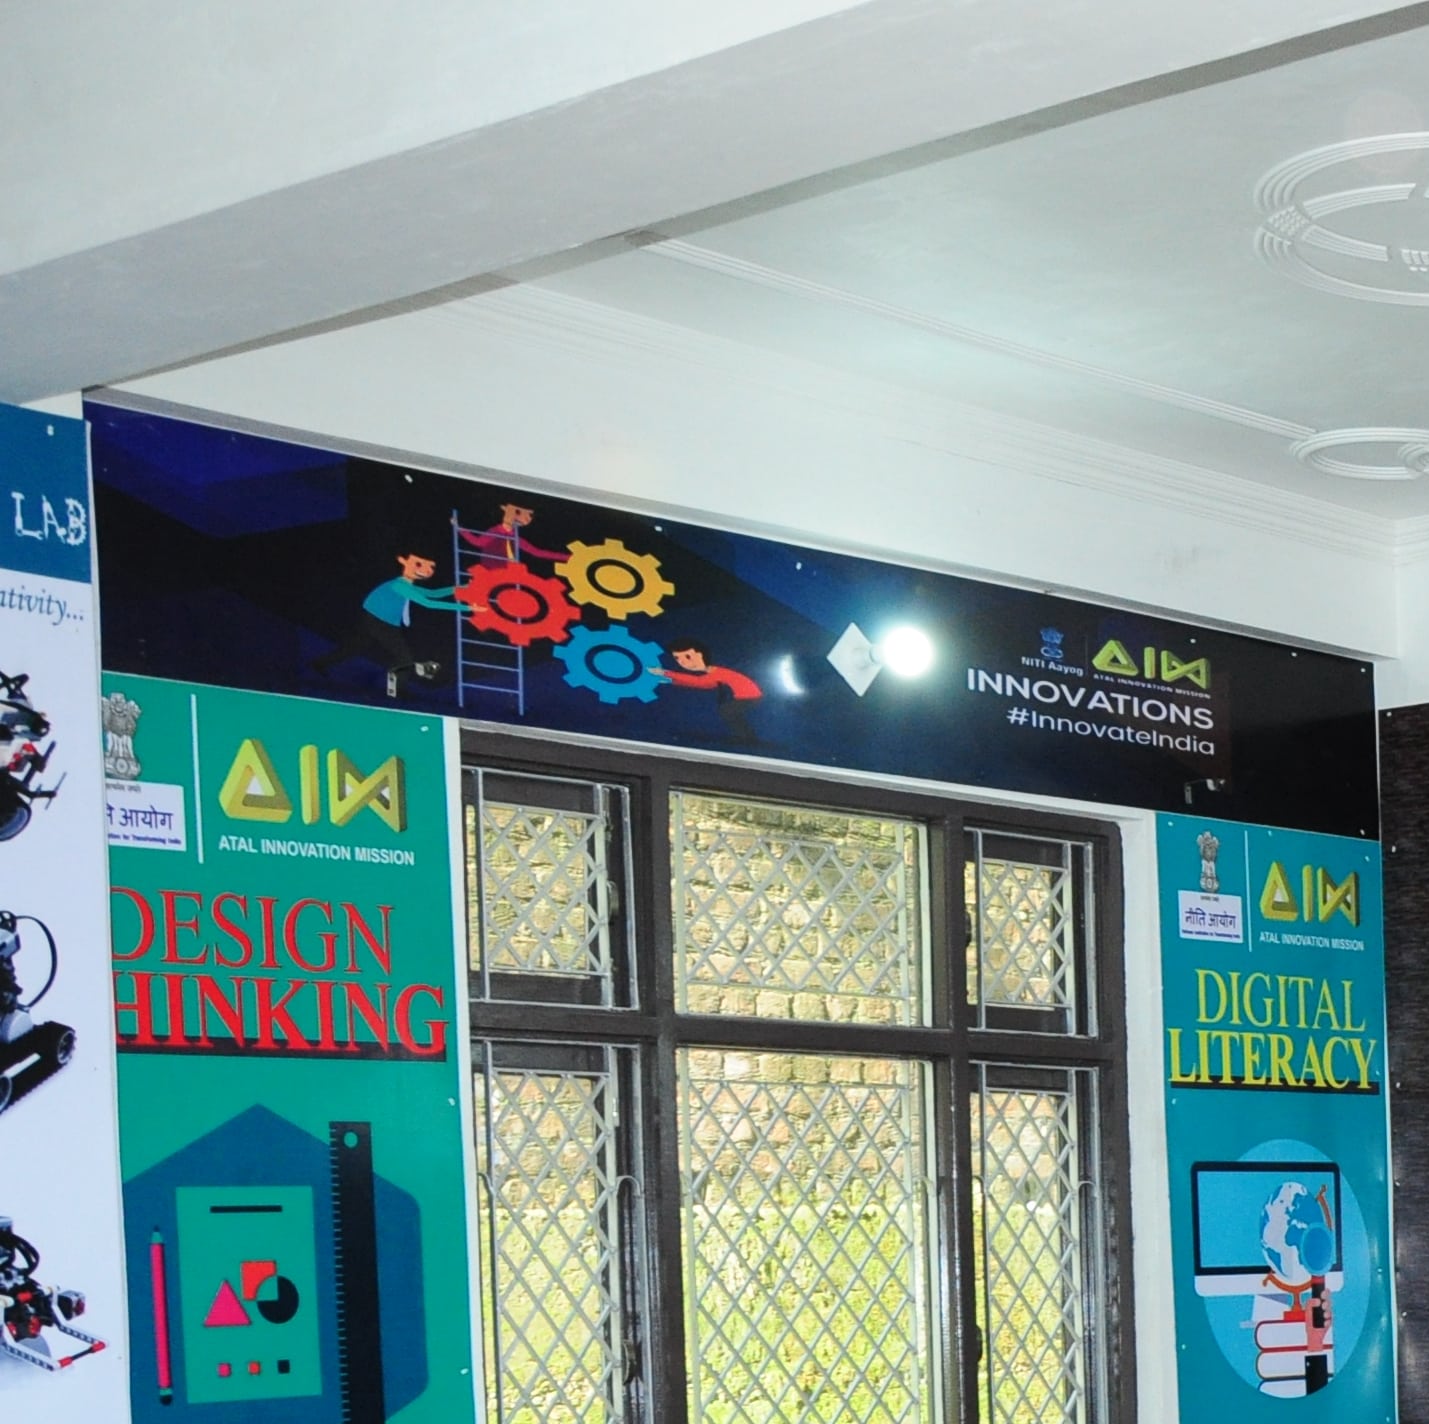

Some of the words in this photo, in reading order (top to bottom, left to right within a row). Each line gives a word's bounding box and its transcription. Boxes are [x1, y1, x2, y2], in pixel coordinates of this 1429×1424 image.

[11, 491, 87, 546] LAB
[1021, 656, 1046, 669] NITI
[1048, 660, 1084, 677] Aayog
[1117, 678, 1174, 694] INNOVATION
[967, 668, 1215, 730] INNOVATIONS
[1006, 706, 1216, 756] #InnovateIndia
[119, 804, 174, 831] आयोग
[218, 835, 258, 854] ATAL
[260, 839, 351, 861] INNOVATION
[354, 846, 416, 866] MISSION
[111, 885, 395, 977] DESIGN
[1259, 931, 1281, 944] ATAL
[1282, 933, 1330, 948] INNOVATION
[1331, 937, 1365, 951] MISSION
[1195, 968, 1366, 1032] DIGITAL
[1167, 1027, 1377, 1089] LITERACY
